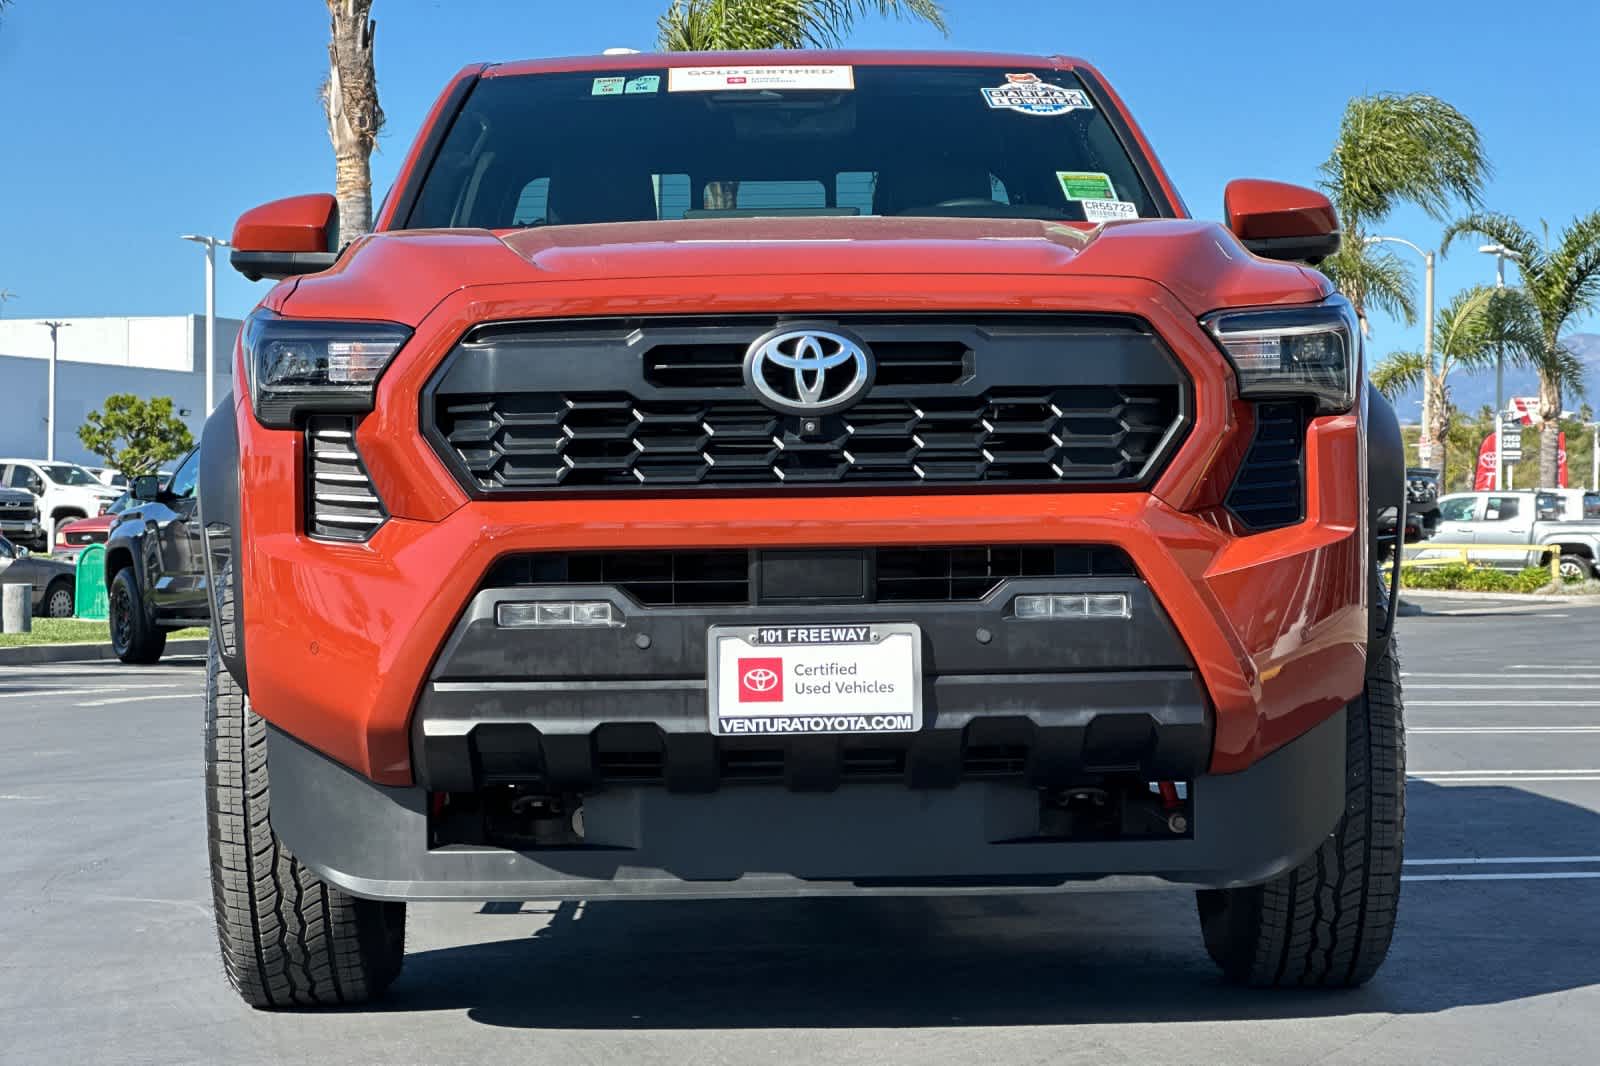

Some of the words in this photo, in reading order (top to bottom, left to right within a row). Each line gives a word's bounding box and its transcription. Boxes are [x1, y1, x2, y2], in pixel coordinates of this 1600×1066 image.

[990, 90, 1079, 98] CARFAX
[1010, 98, 1084, 106] OWNER
[1084, 201, 1135, 213] CR55723
[760, 629, 783, 643] 101
[787, 627, 866, 643] FREEWAY
[794, 662, 857, 676] Certified
[795, 682, 831, 695] Used
[836, 679, 895, 694] Vehicles
[720, 715, 911, 732] VENTURATOYOTA.COM
